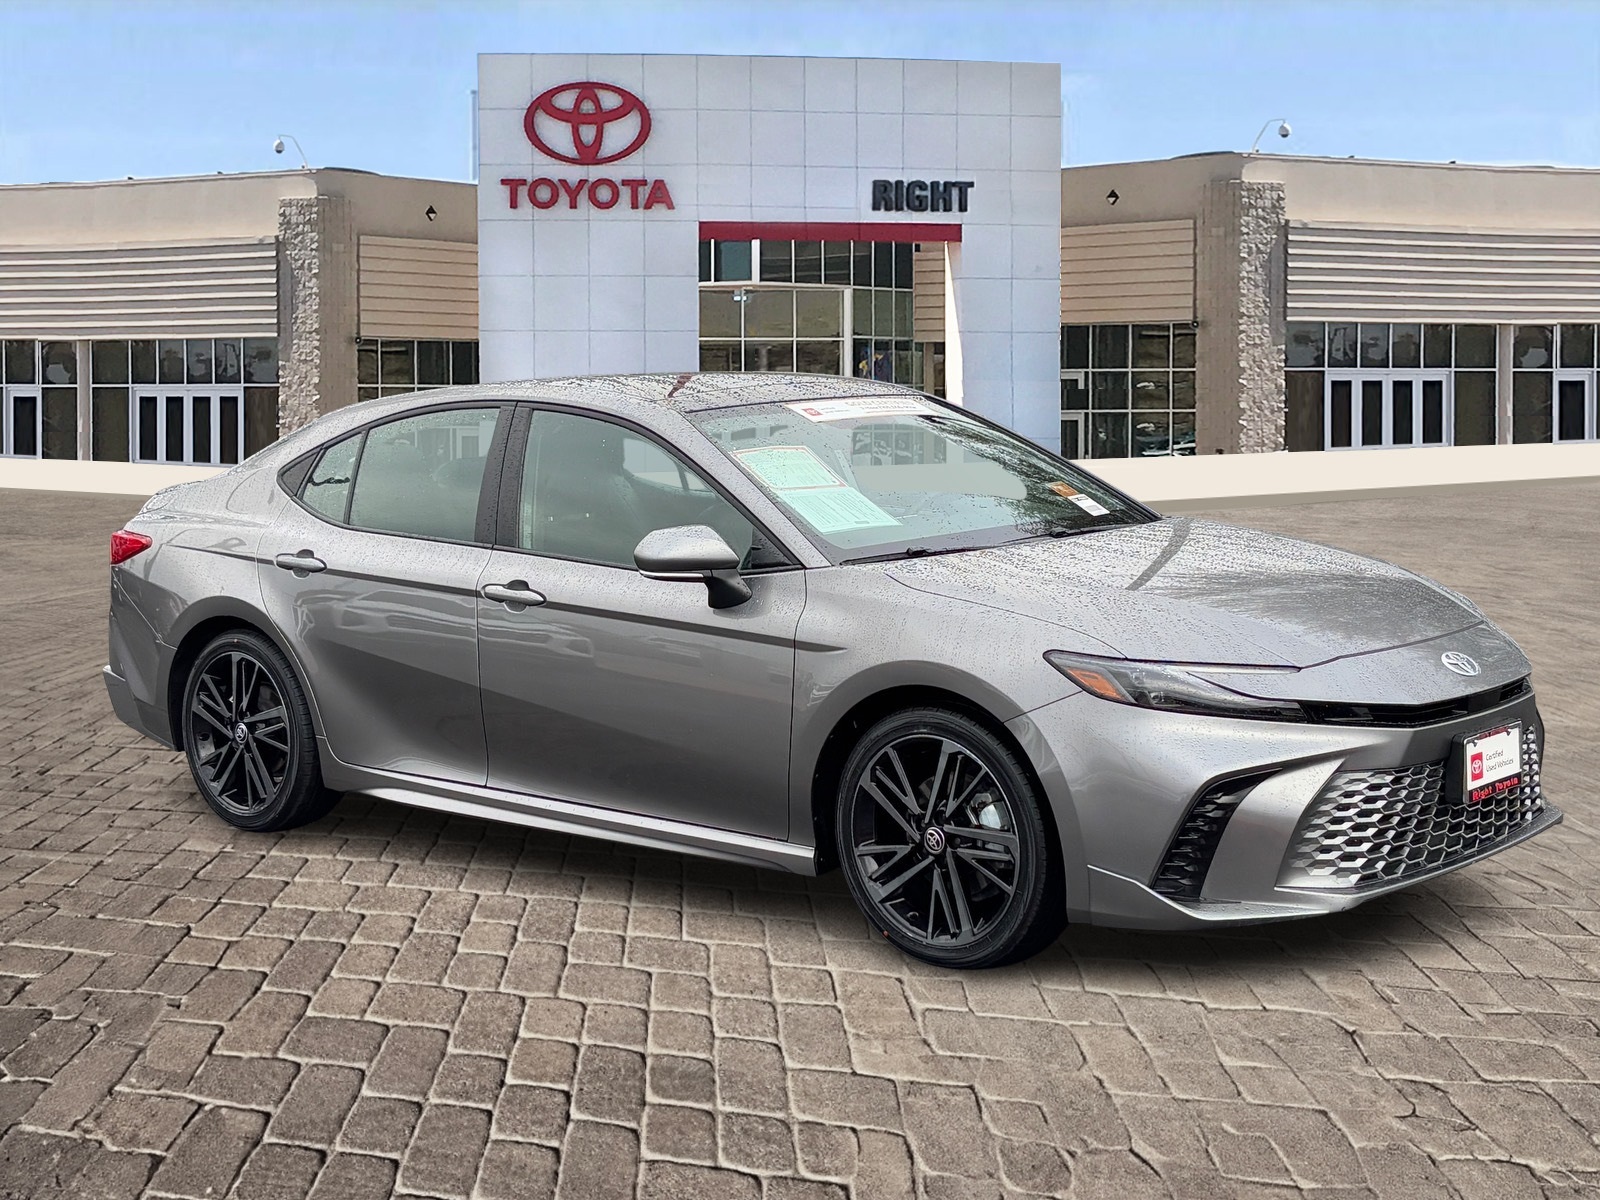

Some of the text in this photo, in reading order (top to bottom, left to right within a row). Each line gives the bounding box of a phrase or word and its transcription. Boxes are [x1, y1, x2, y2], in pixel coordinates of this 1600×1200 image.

[500, 178, 675, 210] TOYOTA
[871, 179, 975, 212] RIGHT
[1485, 749, 1504, 761] Certified
[1486, 758, 1514, 773] Used Vehicles
[1472, 777, 1519, 801] Right Toyota
